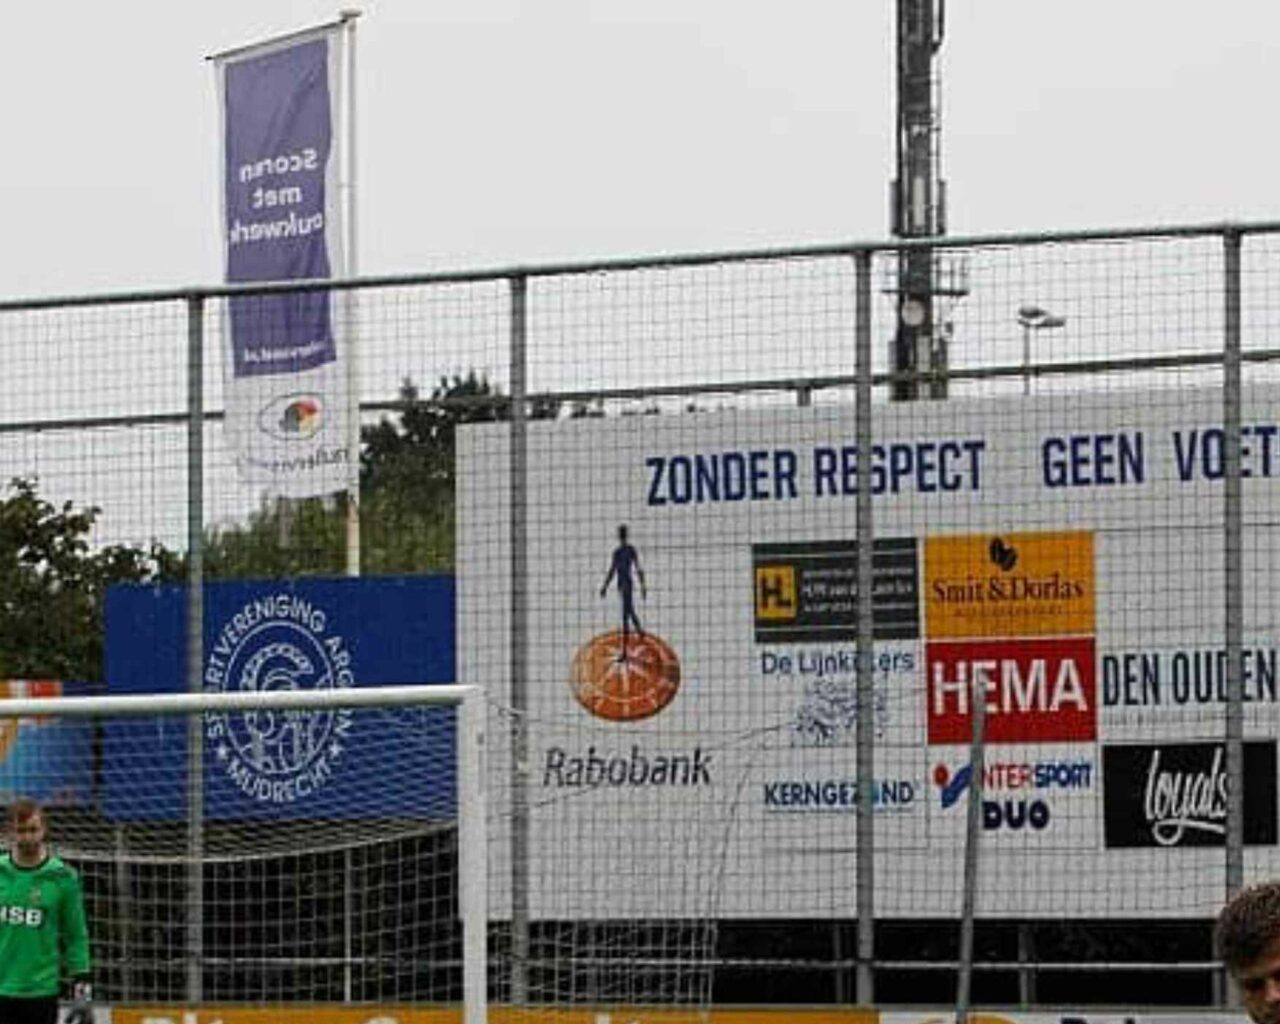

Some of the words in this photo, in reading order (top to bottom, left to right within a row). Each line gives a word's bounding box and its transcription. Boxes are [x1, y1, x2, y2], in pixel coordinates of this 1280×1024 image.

[646, 450, 798, 506] ZONDER
[813, 440, 985, 496] RESPECT
[1042, 432, 1144, 488] GEEN
[932, 574, 984, 603] Smit
[988, 576, 1009, 601] &
[1011, 570, 1084, 600] Dorlas
[762, 652, 792, 675] De
[1102, 653, 1160, 706] DEN
[1172, 649, 1276, 704] OUDEN
[325, 636, 354, 738] ARGN
[932, 659, 1088, 715] HEMA
[543, 745, 712, 787] Rabobank
[980, 763, 1092, 790] NTERSPORT
[982, 800, 1049, 831] DUO
